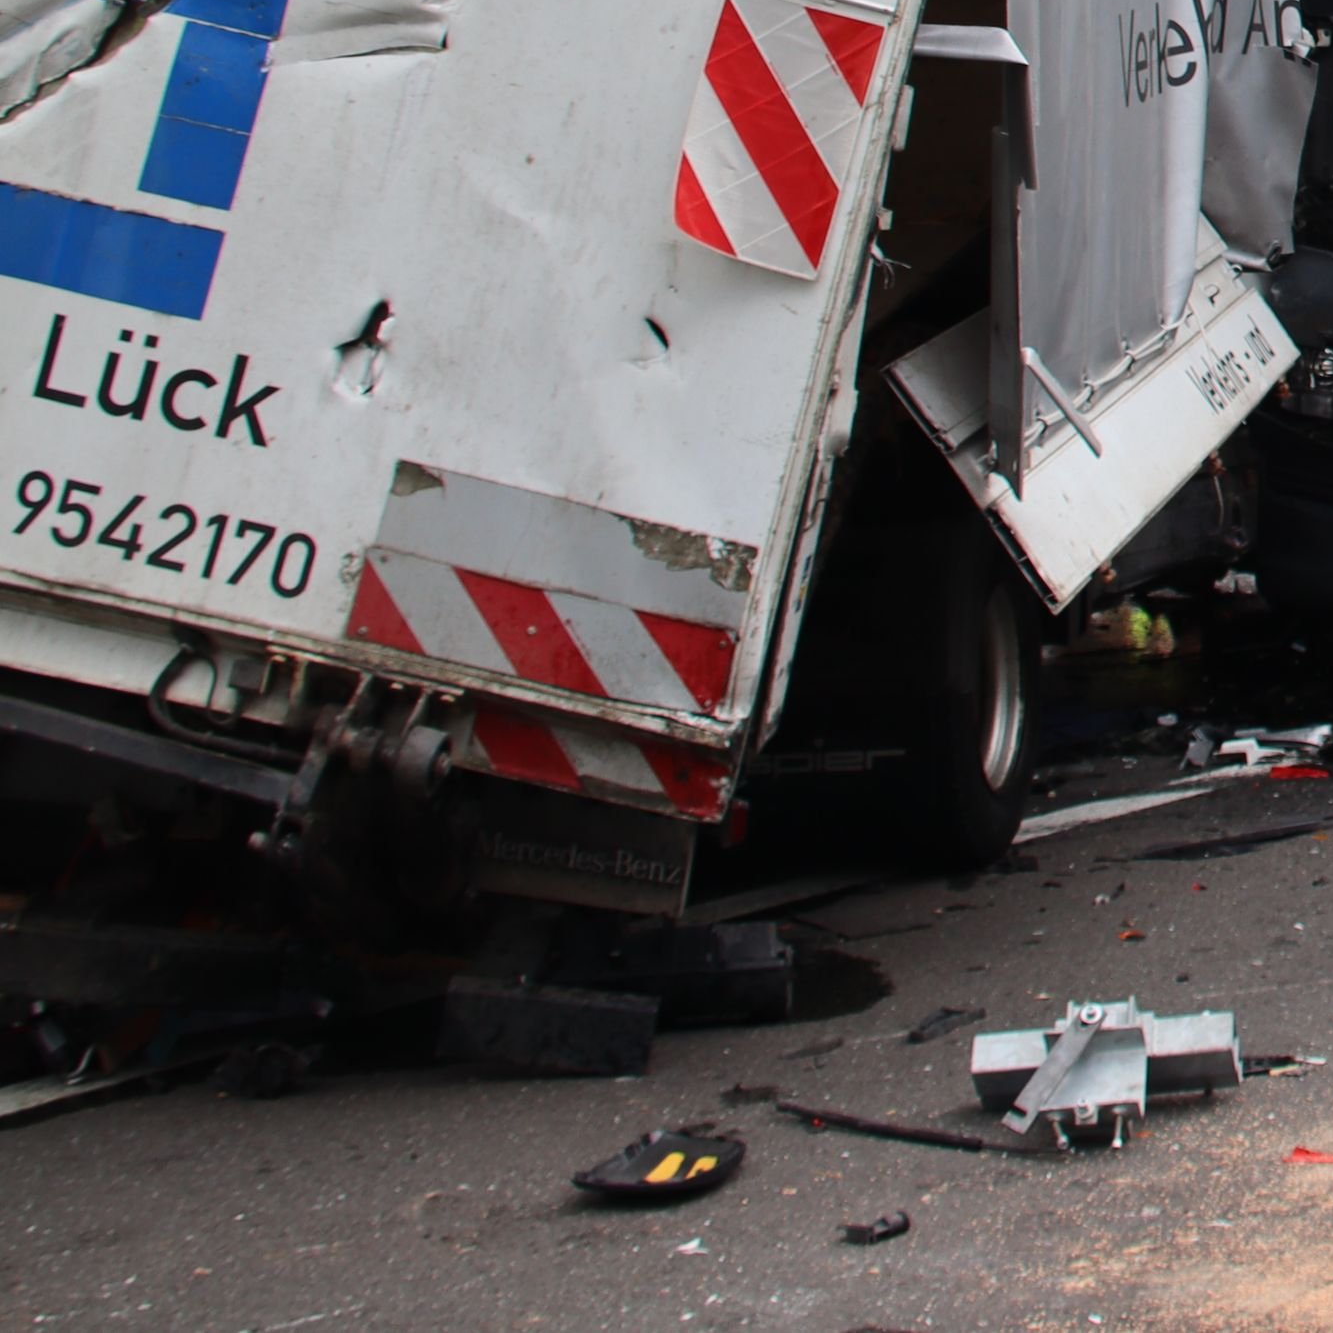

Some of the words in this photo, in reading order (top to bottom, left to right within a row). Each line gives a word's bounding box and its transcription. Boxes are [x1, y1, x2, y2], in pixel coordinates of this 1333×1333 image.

[33, 314, 281, 447] Lück
[12, 470, 317, 600] 9542170
[477, 827, 682, 885] Mercedes-Benz
